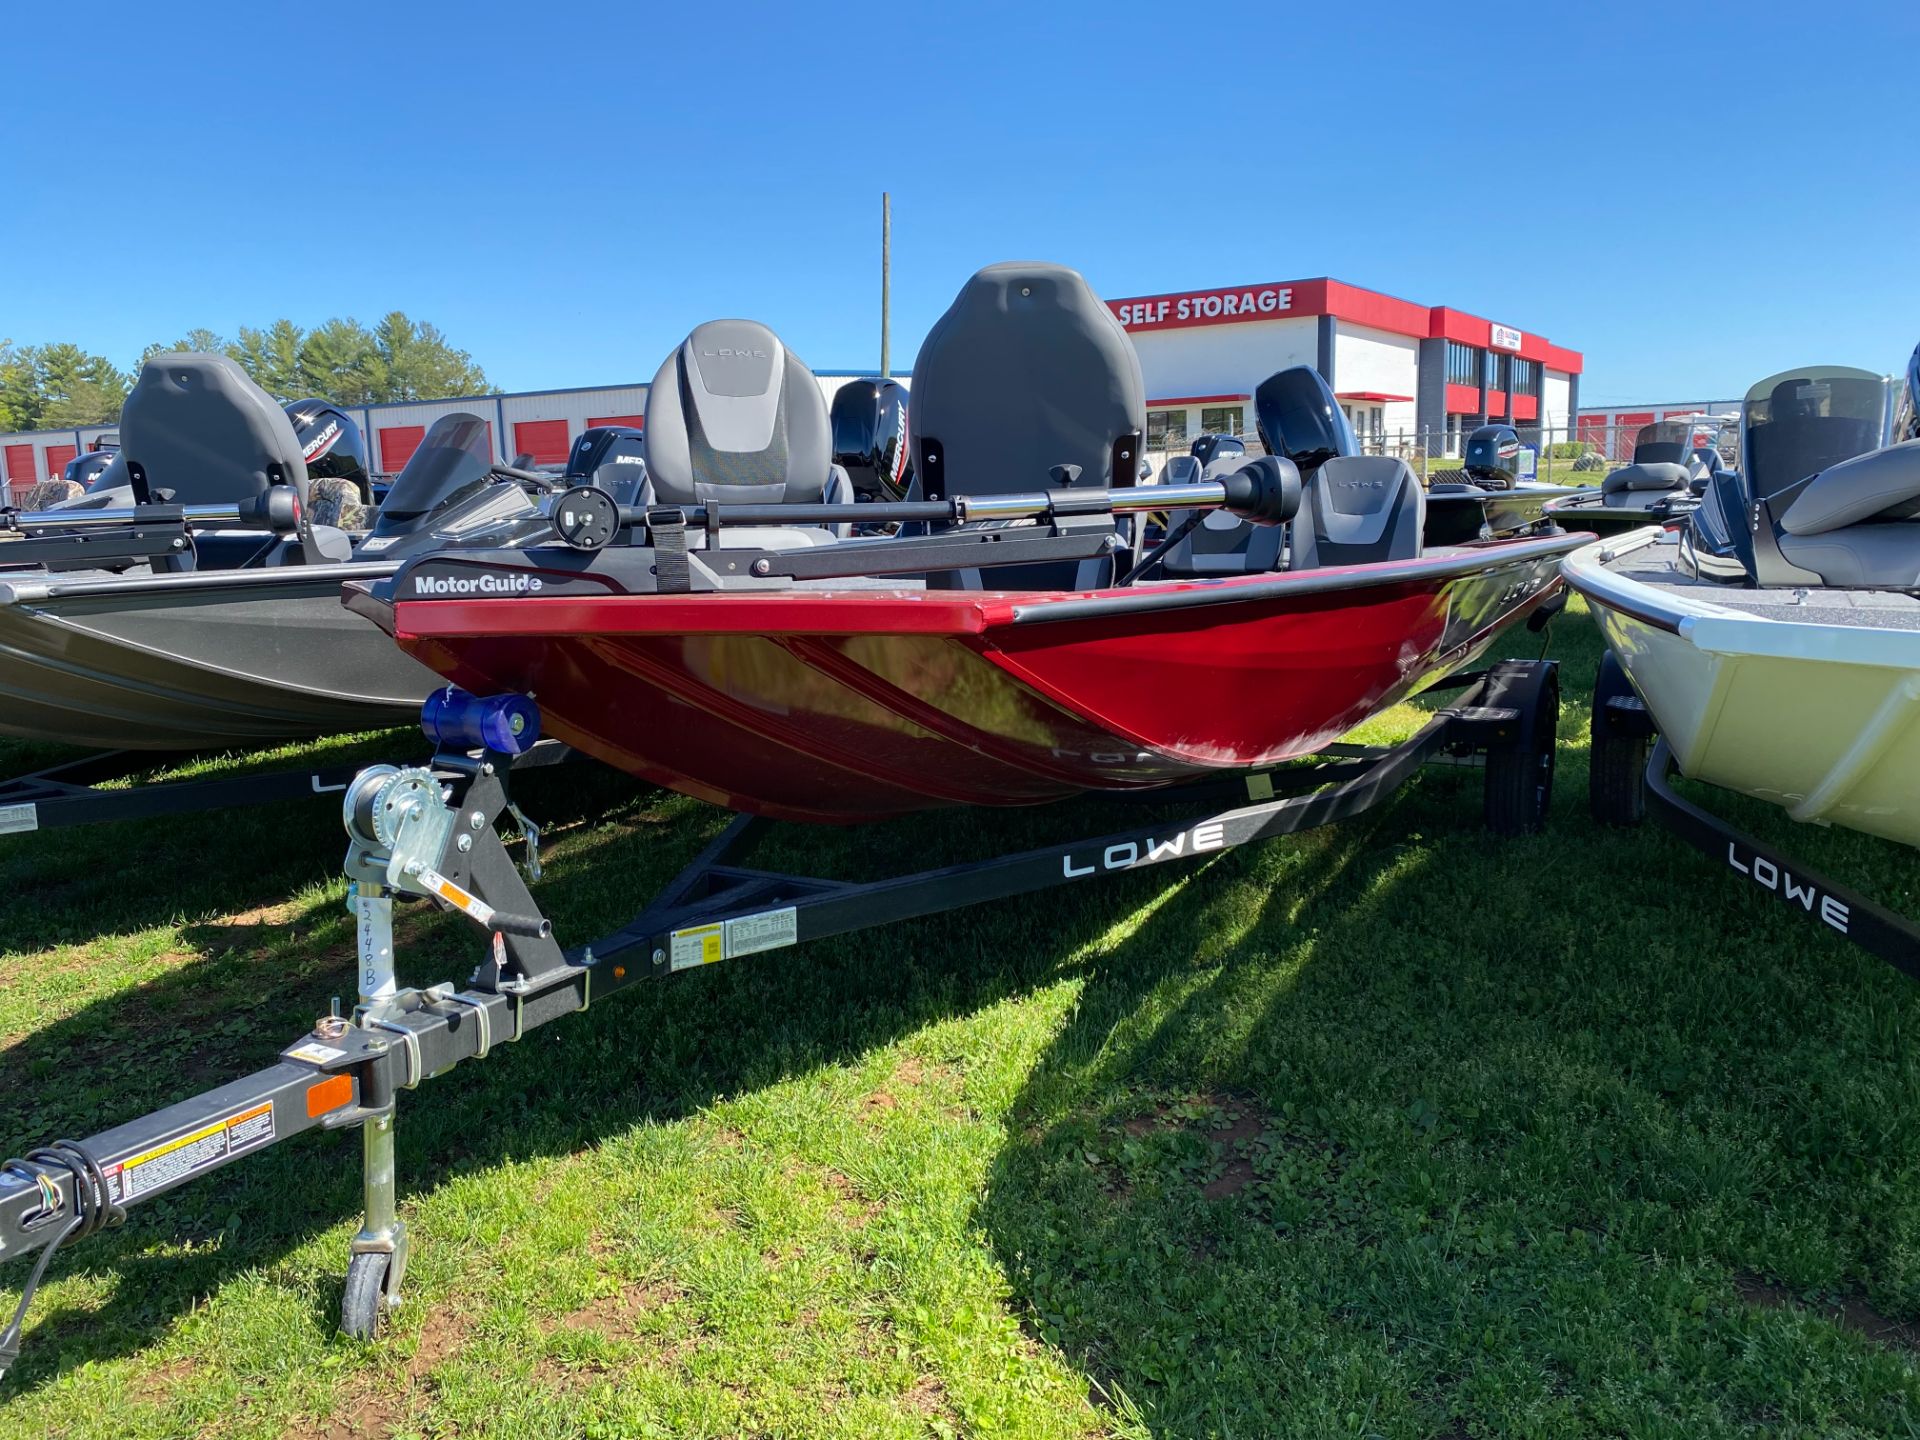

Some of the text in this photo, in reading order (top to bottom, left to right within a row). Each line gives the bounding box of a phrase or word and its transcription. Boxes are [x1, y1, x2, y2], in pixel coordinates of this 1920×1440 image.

[1119, 288, 1292, 326] SELF STORAGE
[703, 349, 767, 359] LOWE
[890, 400, 905, 482] MERCURY
[415, 574, 543, 594] MotorGuide
[1063, 824, 1224, 878] LOWE
[1729, 842, 1849, 934] LOWE
